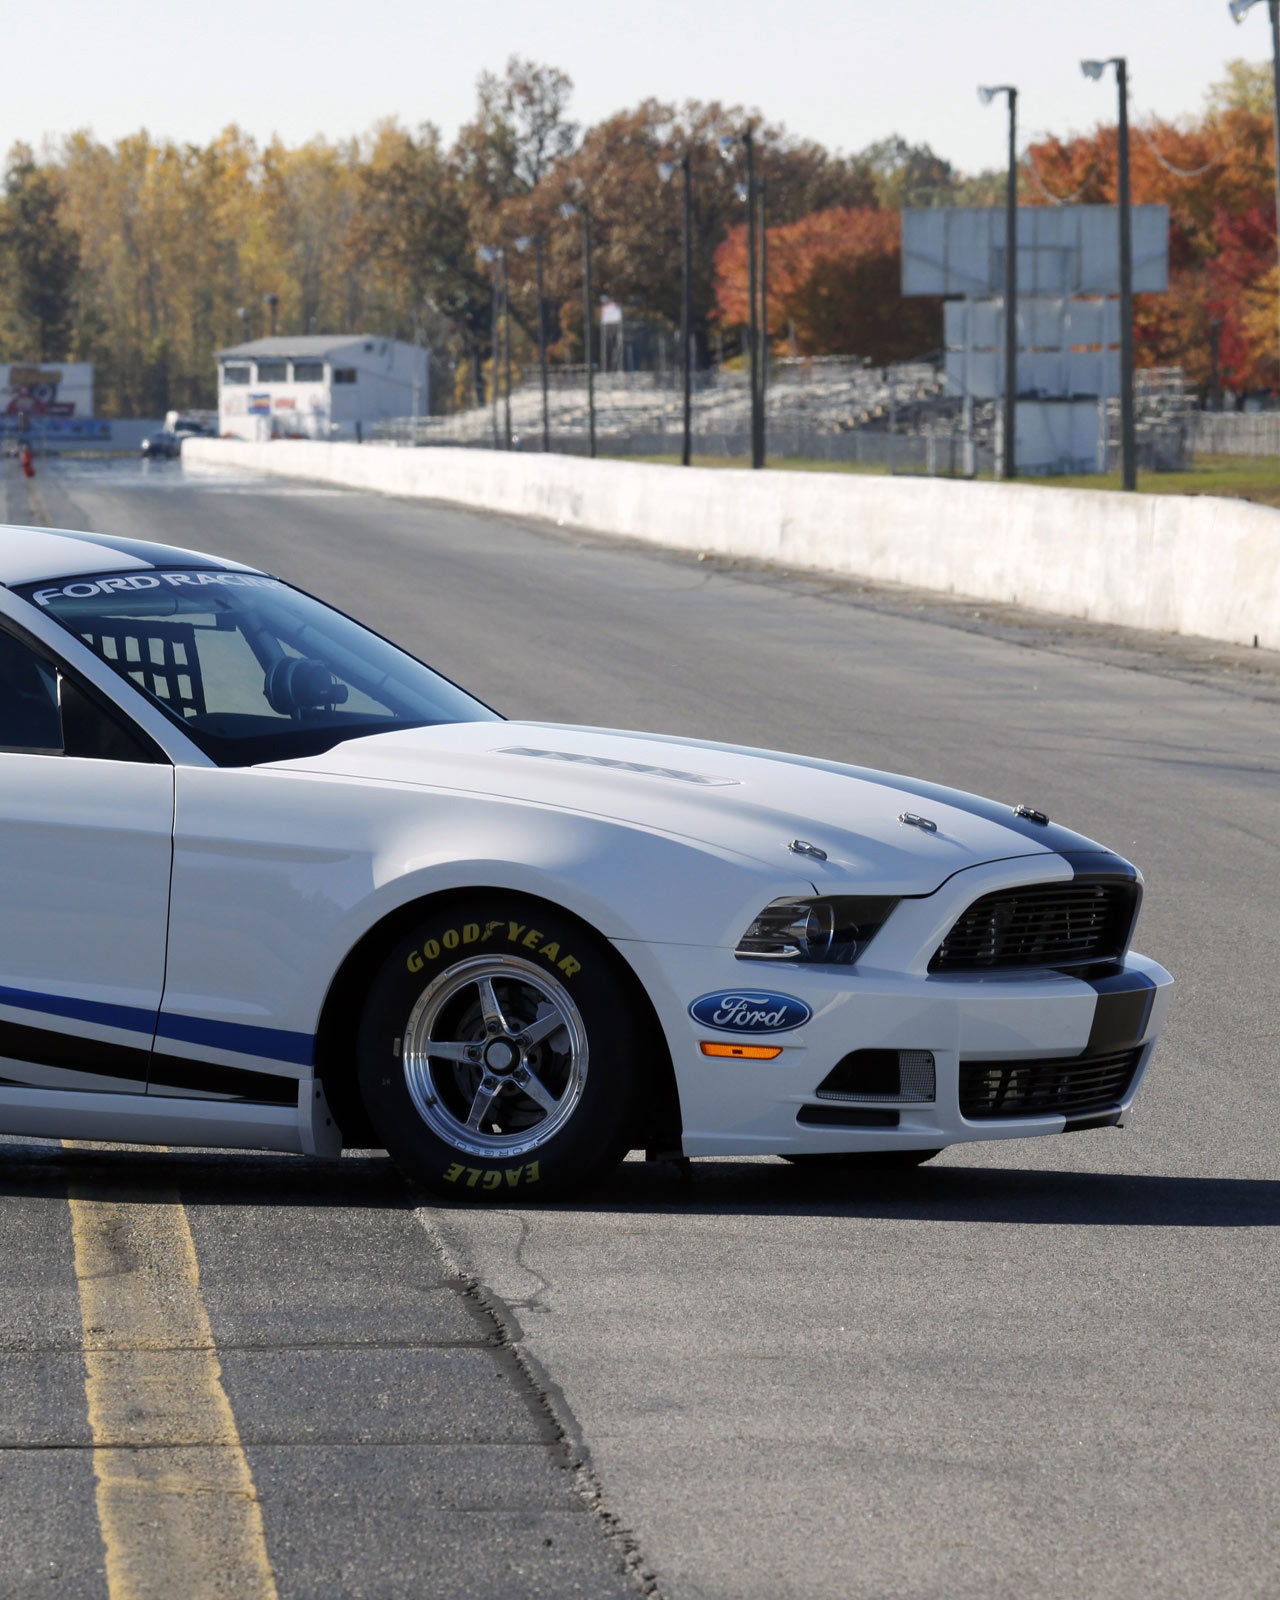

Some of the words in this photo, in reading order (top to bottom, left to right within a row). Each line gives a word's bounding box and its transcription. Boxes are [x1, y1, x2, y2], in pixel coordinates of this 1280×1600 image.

[33, 575, 160, 606] FORD
[162, 573, 283, 591] RACIN
[713, 996, 786, 1026] Ford
[443, 1160, 541, 1190] EAGLE
